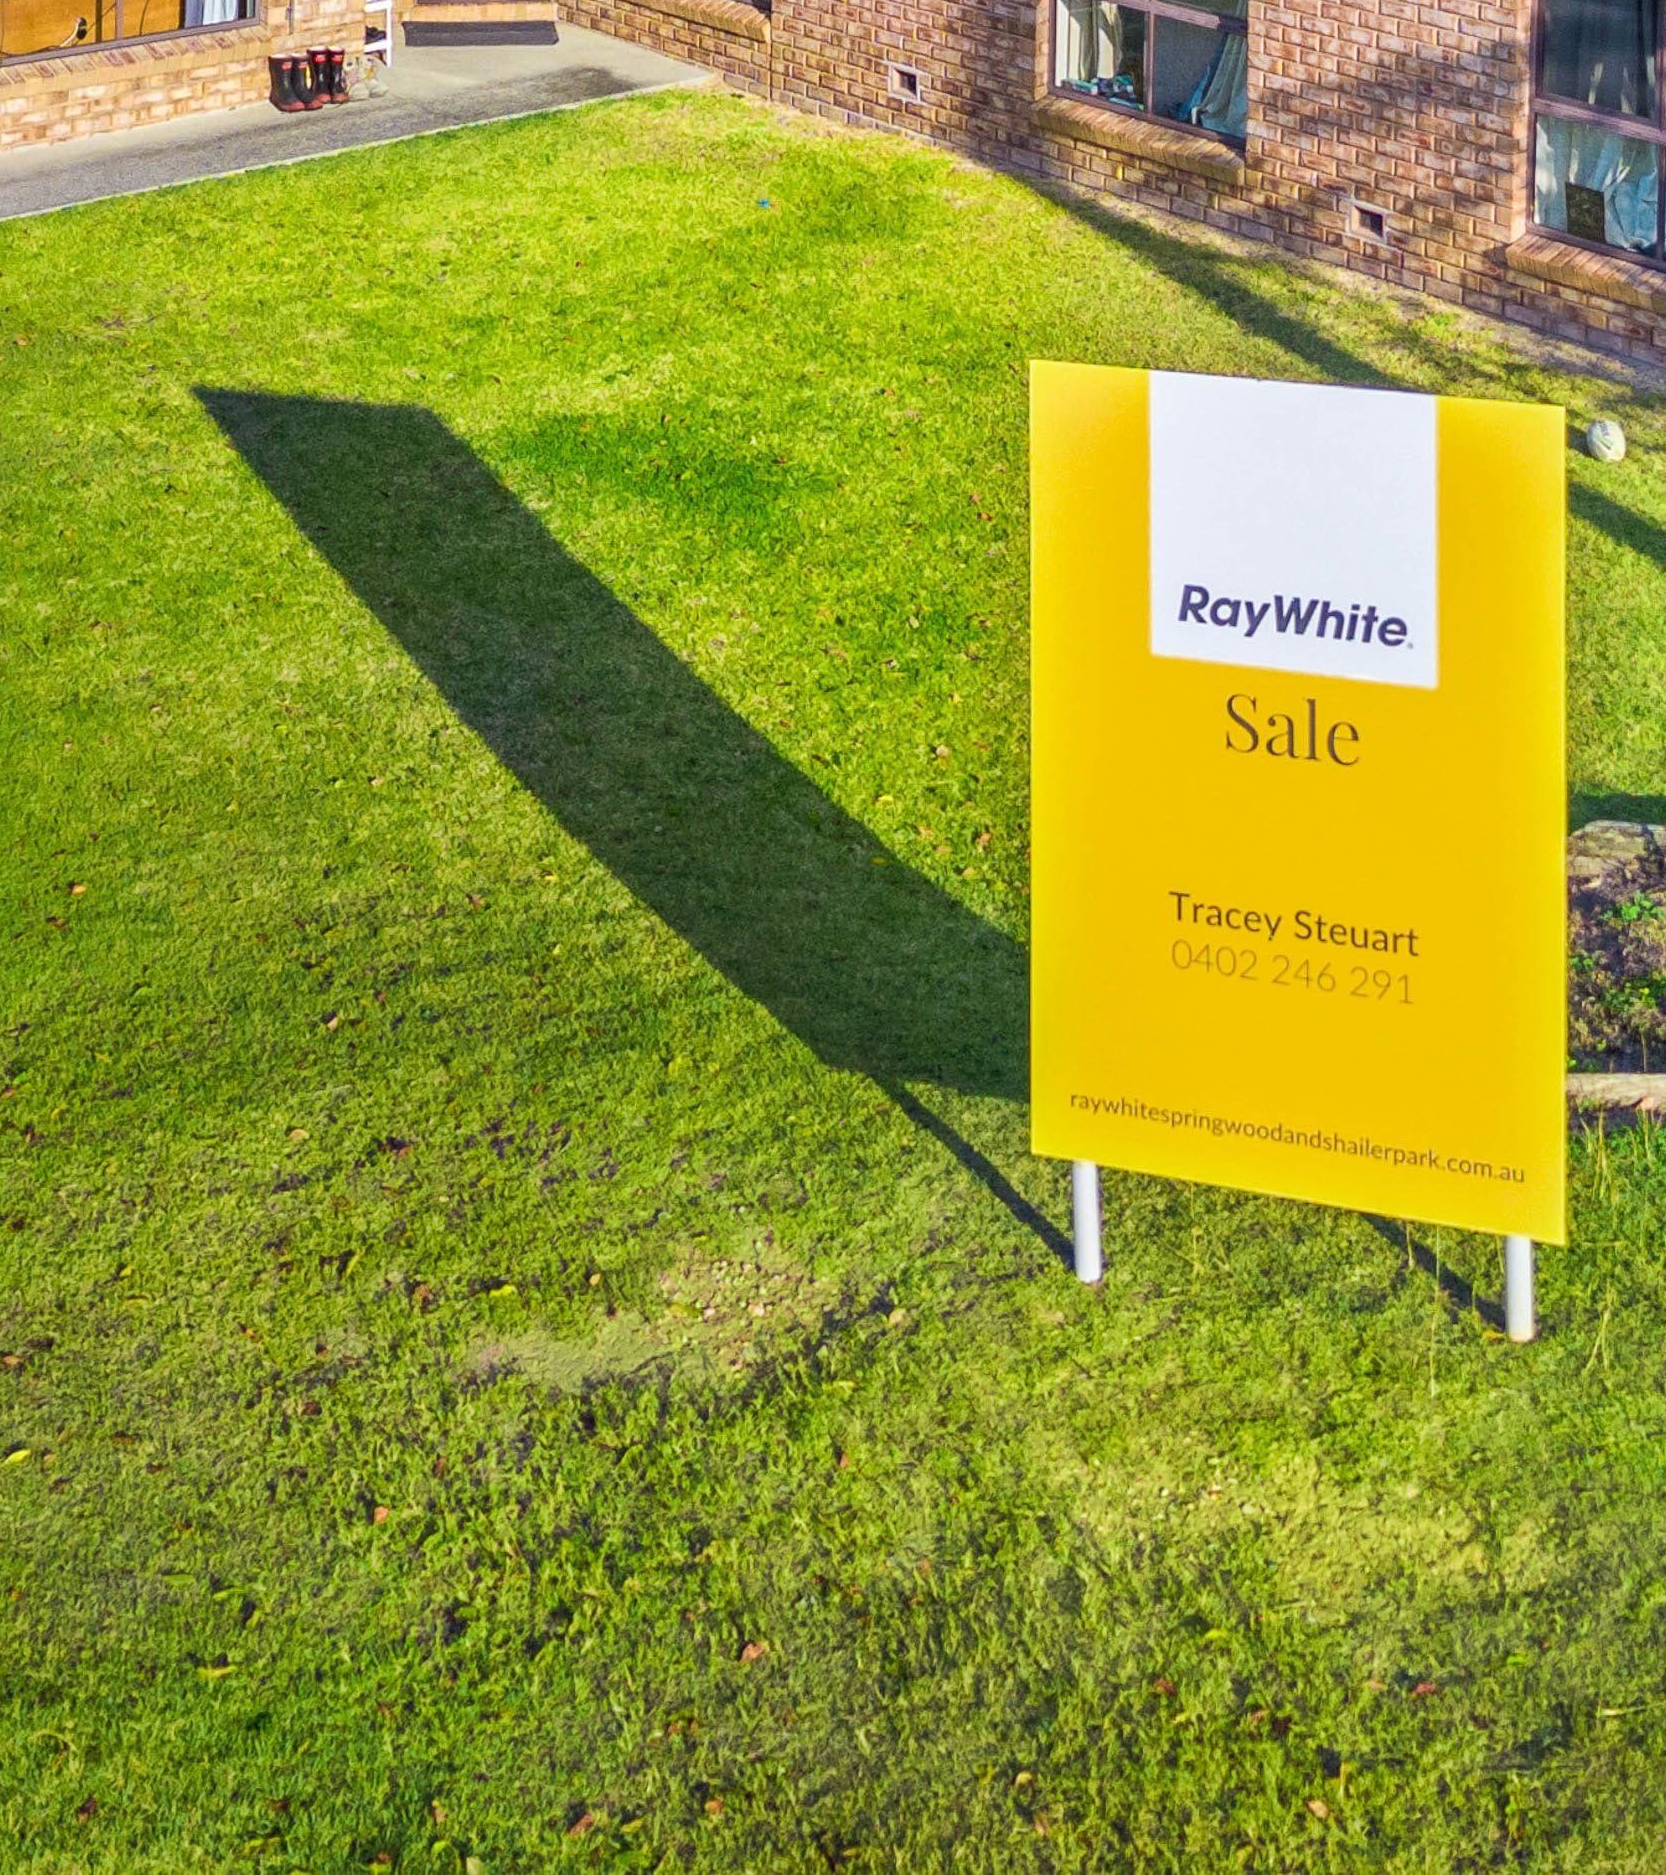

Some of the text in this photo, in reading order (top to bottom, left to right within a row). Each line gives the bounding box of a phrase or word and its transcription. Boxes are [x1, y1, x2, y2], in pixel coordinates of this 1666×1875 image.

[1178, 584, 1408, 646] RayWhite
[1226, 694, 1359, 766] Sale
[1169, 890, 1420, 957] Tracey Steuart
[1172, 939, 1413, 1005] 0402 246 291
[1070, 1092, 1525, 1183] raywhitespringwoodandshailerpark.com.au
